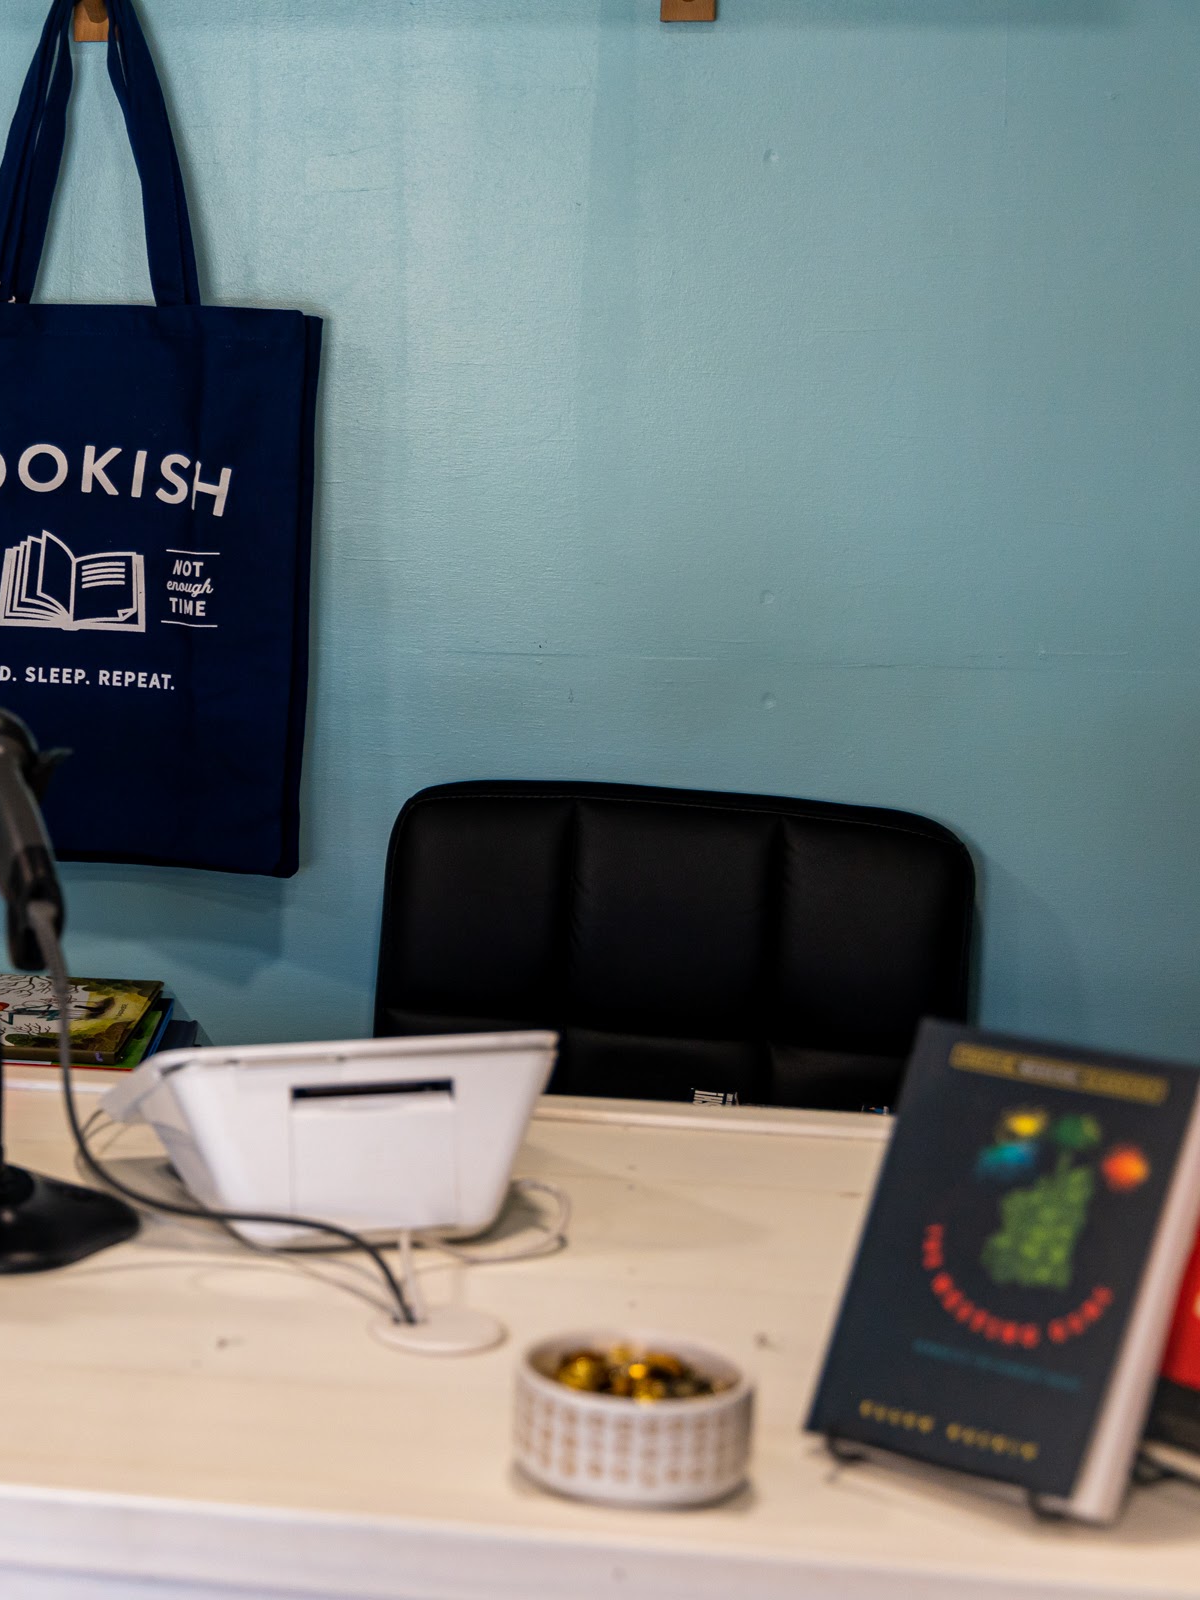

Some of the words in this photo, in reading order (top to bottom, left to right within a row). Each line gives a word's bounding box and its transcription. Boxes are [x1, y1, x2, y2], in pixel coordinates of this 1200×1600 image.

[172, 559, 204, 578] NOT
[166, 577, 214, 598] enough
[169, 597, 207, 617] TIME
[25, 666, 90, 685] SLEEP.
[98, 669, 175, 691] REPEAT.
